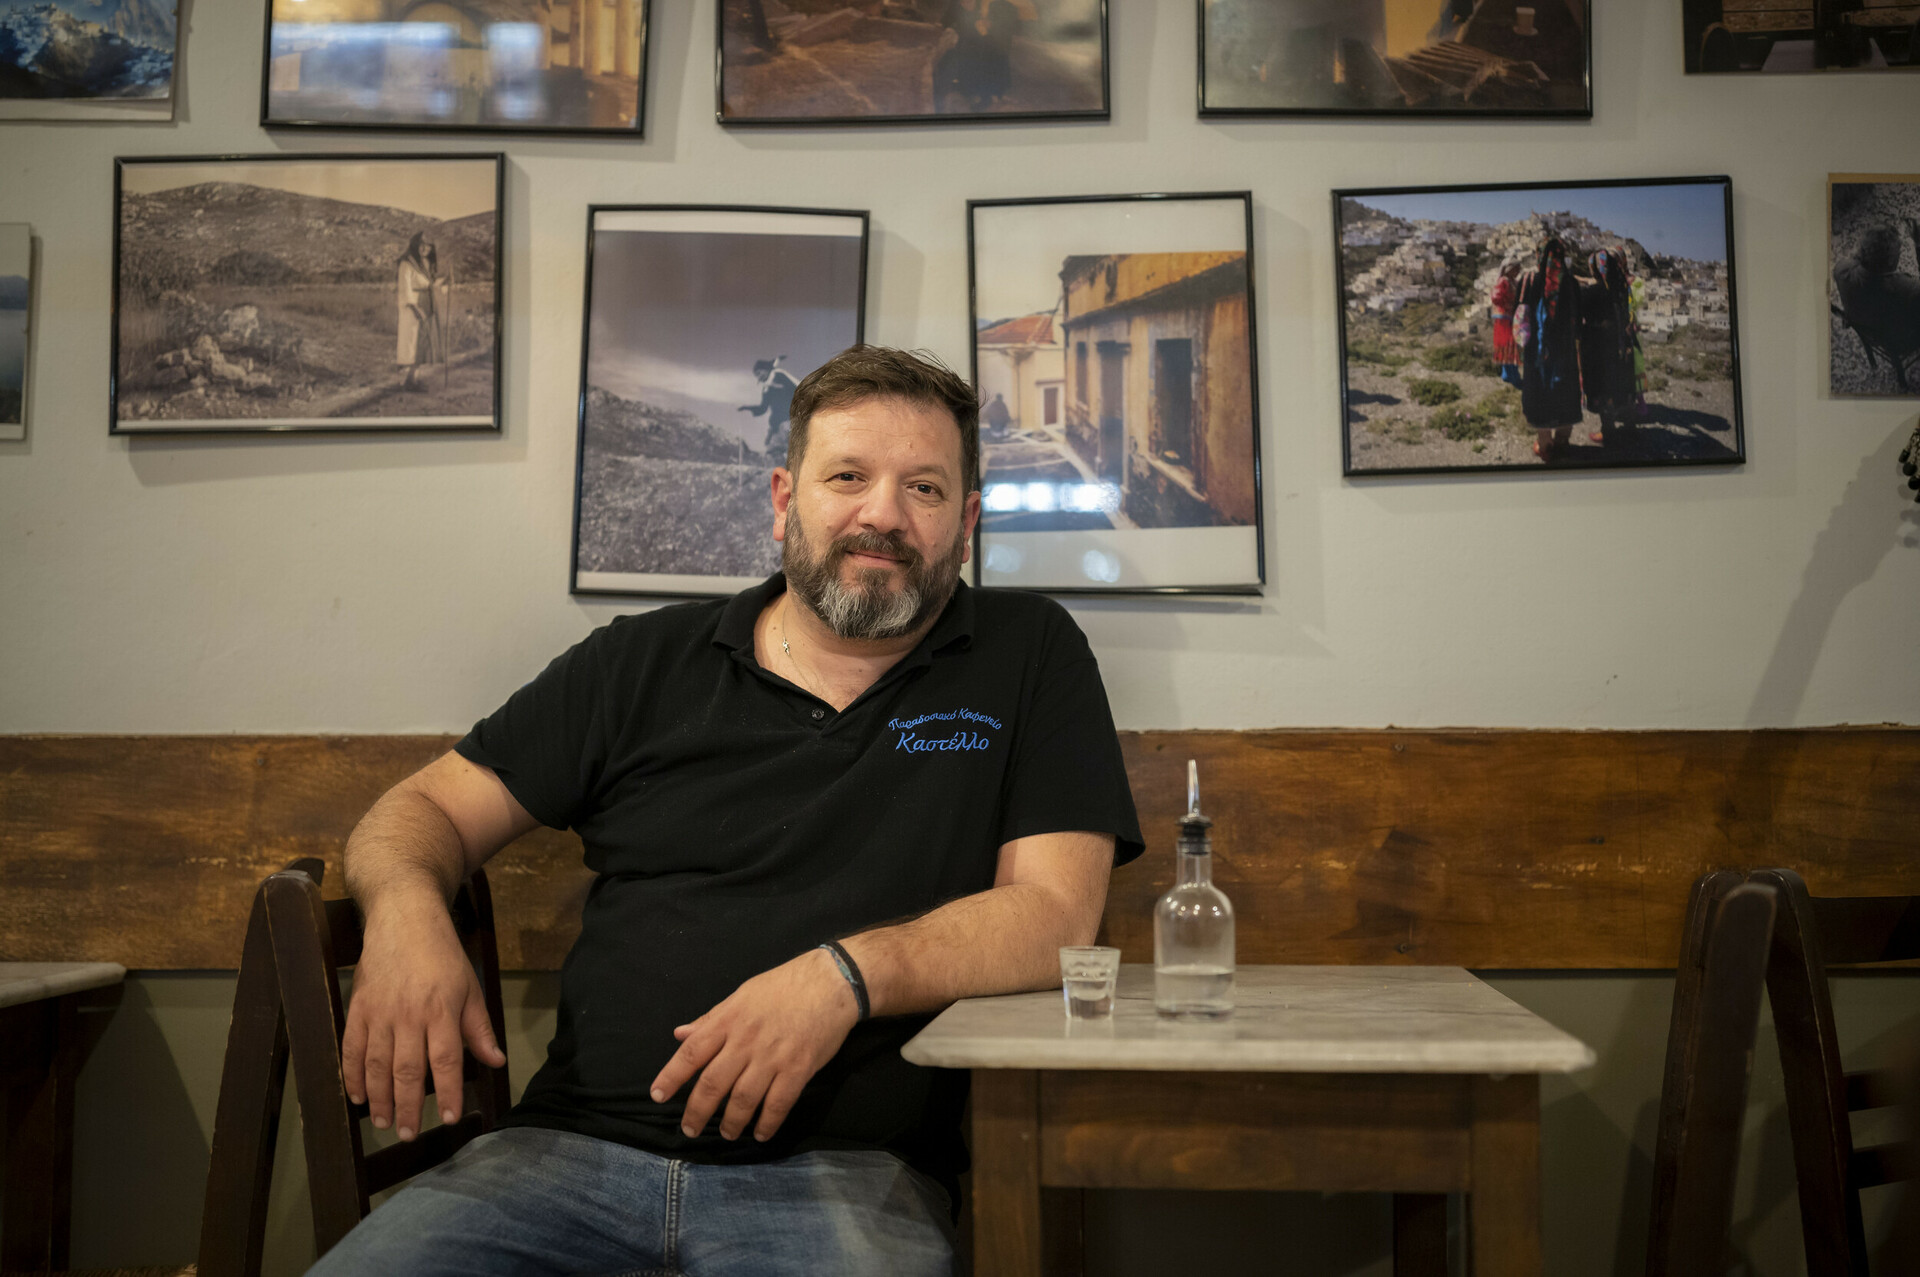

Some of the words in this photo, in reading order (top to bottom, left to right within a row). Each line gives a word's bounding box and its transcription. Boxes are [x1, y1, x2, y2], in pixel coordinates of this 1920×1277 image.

[888, 709, 957, 731] Παραδοσιακό
[958, 707, 1002, 730] Καφενείο
[895, 731, 990, 754] Καστέλλο
